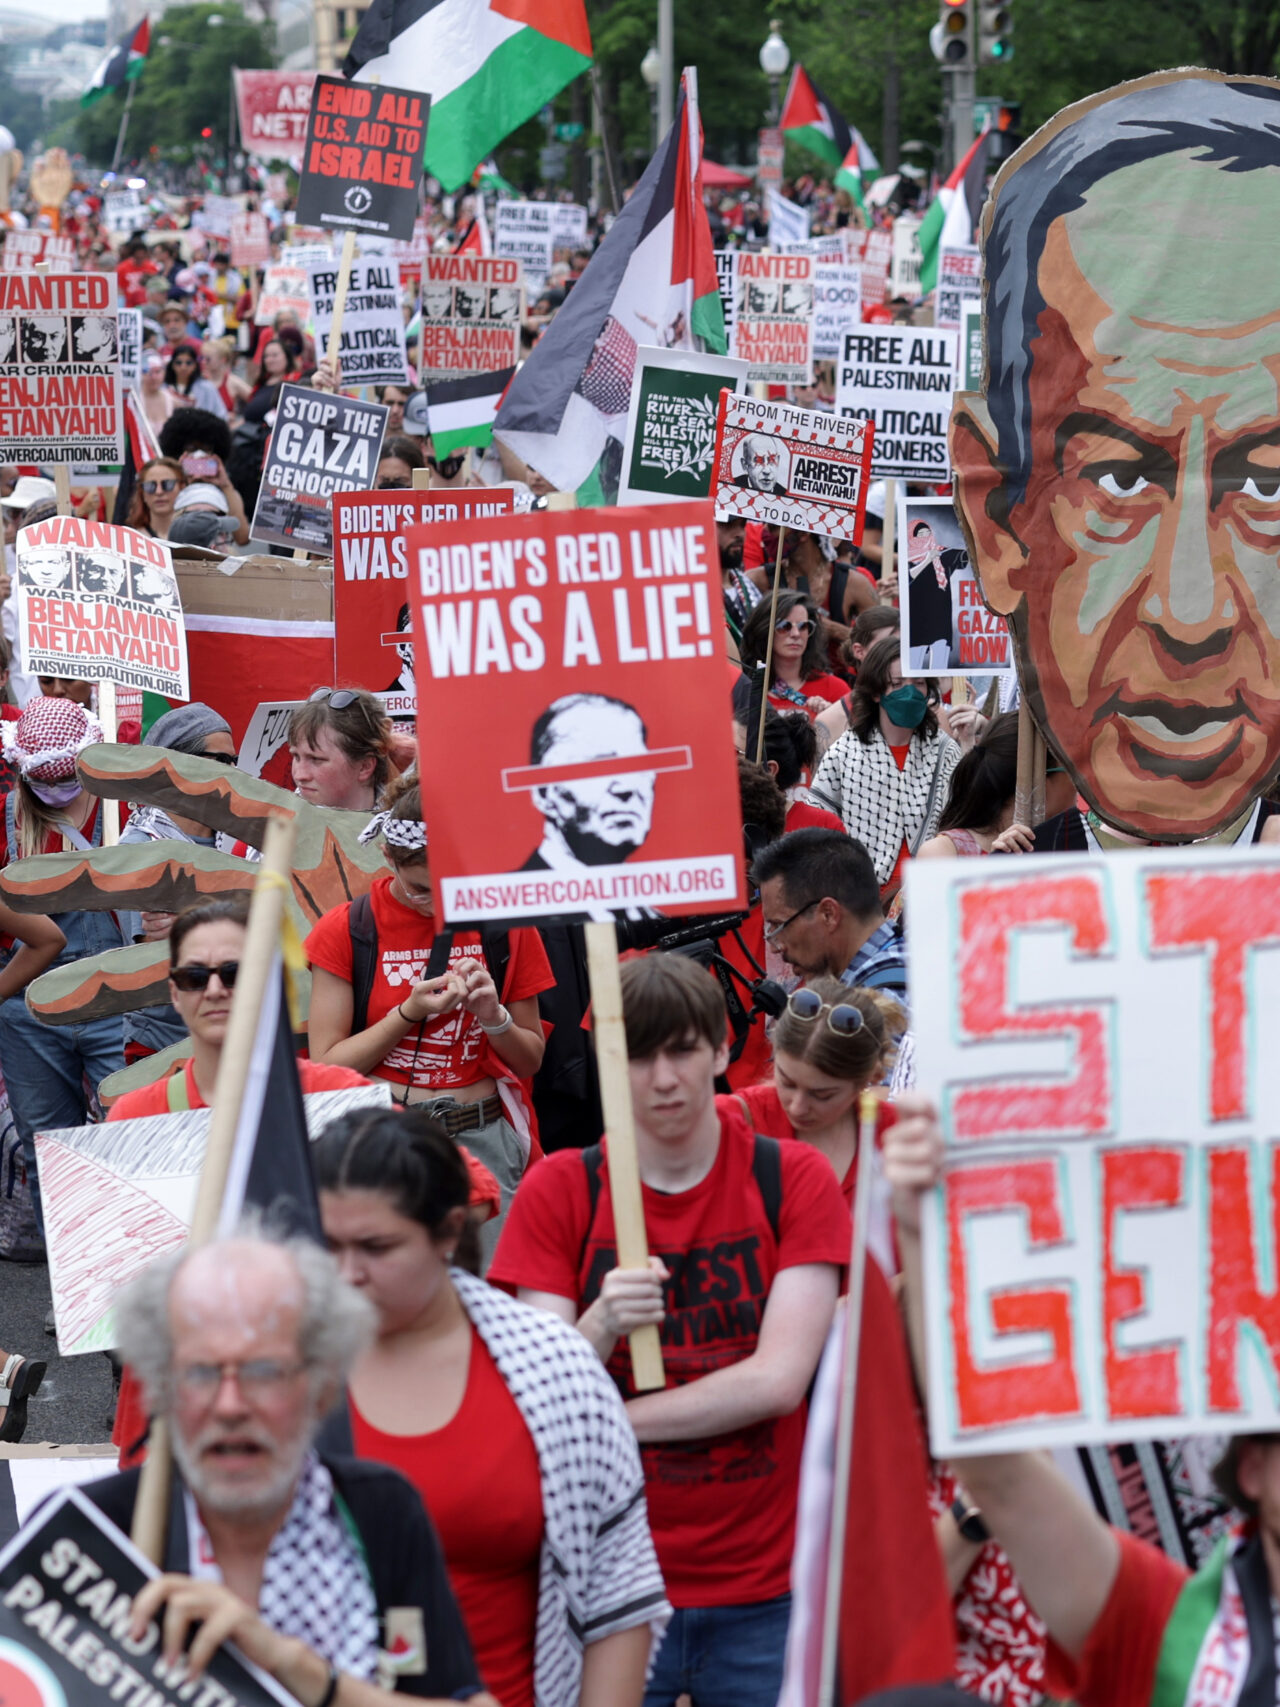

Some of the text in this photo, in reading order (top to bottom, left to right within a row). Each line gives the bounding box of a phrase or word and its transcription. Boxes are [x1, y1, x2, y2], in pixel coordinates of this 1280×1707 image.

[317, 83, 423, 127] END ALL
[313, 115, 420, 153] U.S. AID TO
[308, 142, 415, 189] ISRAEL
[427, 257, 518, 283] WANTED
[738, 254, 810, 279] ANTED
[313, 267, 395, 295] FRE ALL
[423, 327, 515, 351] BENJAMIN
[735, 323, 808, 345] NJAMIN
[338, 352, 403, 371] RISONERS
[736, 344, 808, 364] TANYAHU
[844, 335, 903, 364] FREE
[909, 339, 951, 367] ALL
[0, 365, 114, 377] AR CRIMINAL
[842, 368, 951, 392] PALESTINIAN
[0, 376, 114, 407] ENJAMIN
[648, 393, 686, 404] FROM THE
[0, 408, 116, 436] ETANYAHU
[283, 395, 382, 438] STOP THE
[646, 400, 694, 416] RIVER
[660, 415, 675, 423] THE
[677, 416, 706, 429] SEA
[737, 401, 855, 437] FROM THE RIVER
[841, 407, 946, 437] POLITICAL
[0, 447, 118, 463] SWERCOALITION.ORG
[275, 422, 370, 480] GAZA
[641, 445, 681, 461] FREE
[873, 438, 945, 462] SONERS
[794, 458, 858, 487] ARREST
[793, 478, 856, 500] NETANYAHU!
[340, 504, 414, 534] BIDEN'S
[763, 507, 805, 526] TO D.C.
[25, 518, 166, 569] WANTED
[340, 536, 409, 582] WAS
[418, 525, 707, 597] BIDEN'S RED LINE
[26, 588, 176, 621] WAR CRIMINAL
[27, 597, 179, 647] BENJAMIN
[422, 582, 714, 679] WAS A LIE!
[958, 610, 1008, 634] GAZA
[28, 624, 180, 672] NETANYAHU
[960, 636, 1008, 664] NOW
[28, 659, 182, 697] ANSWERCOALITION.ORG
[50, 651, 88, 660] CRIMES
[89, 655, 130, 667] AGAINST
[132, 663, 181, 677] HUMANITY
[454, 867, 725, 911] ANSWERCOALITION.ORG
[382, 950, 411, 962] ARMS
